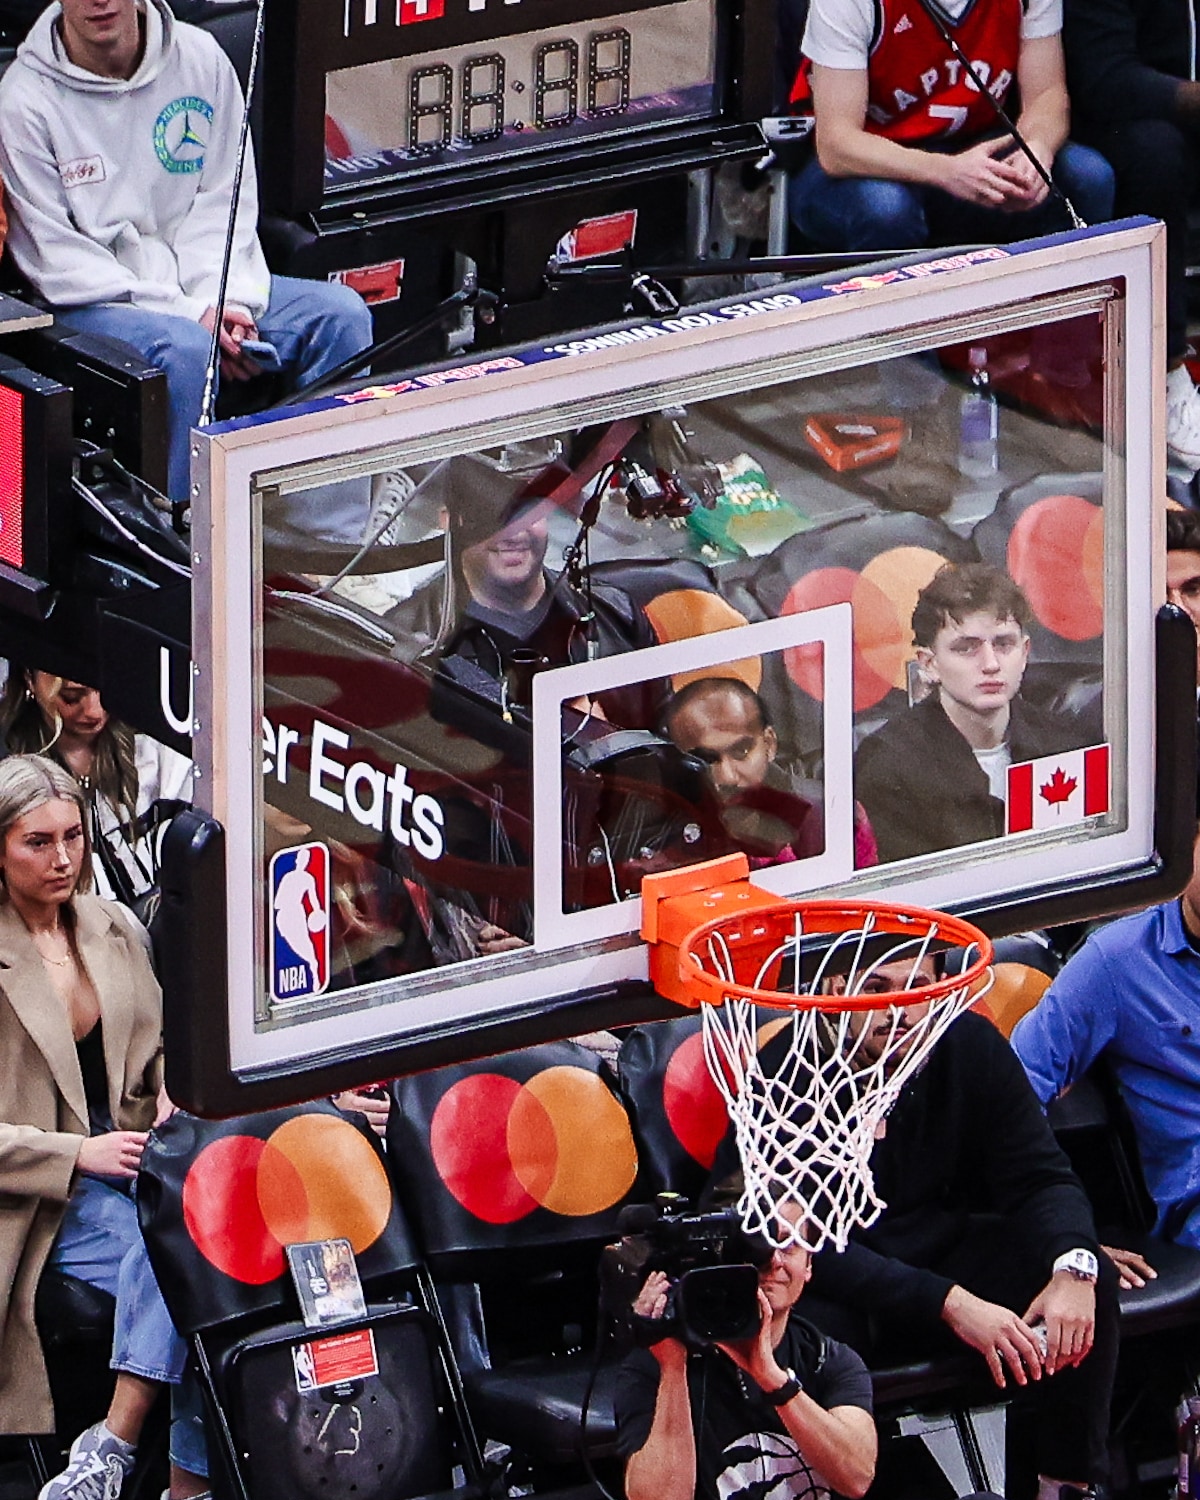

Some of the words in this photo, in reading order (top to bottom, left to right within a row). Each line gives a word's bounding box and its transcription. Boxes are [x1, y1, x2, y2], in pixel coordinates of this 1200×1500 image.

[928, 104, 969, 137] 7
[719, 294, 802, 319] GIVES
[661, 312, 727, 332] YOU
[310, 719, 445, 861] Eats
[278, 964, 308, 994] NBA
